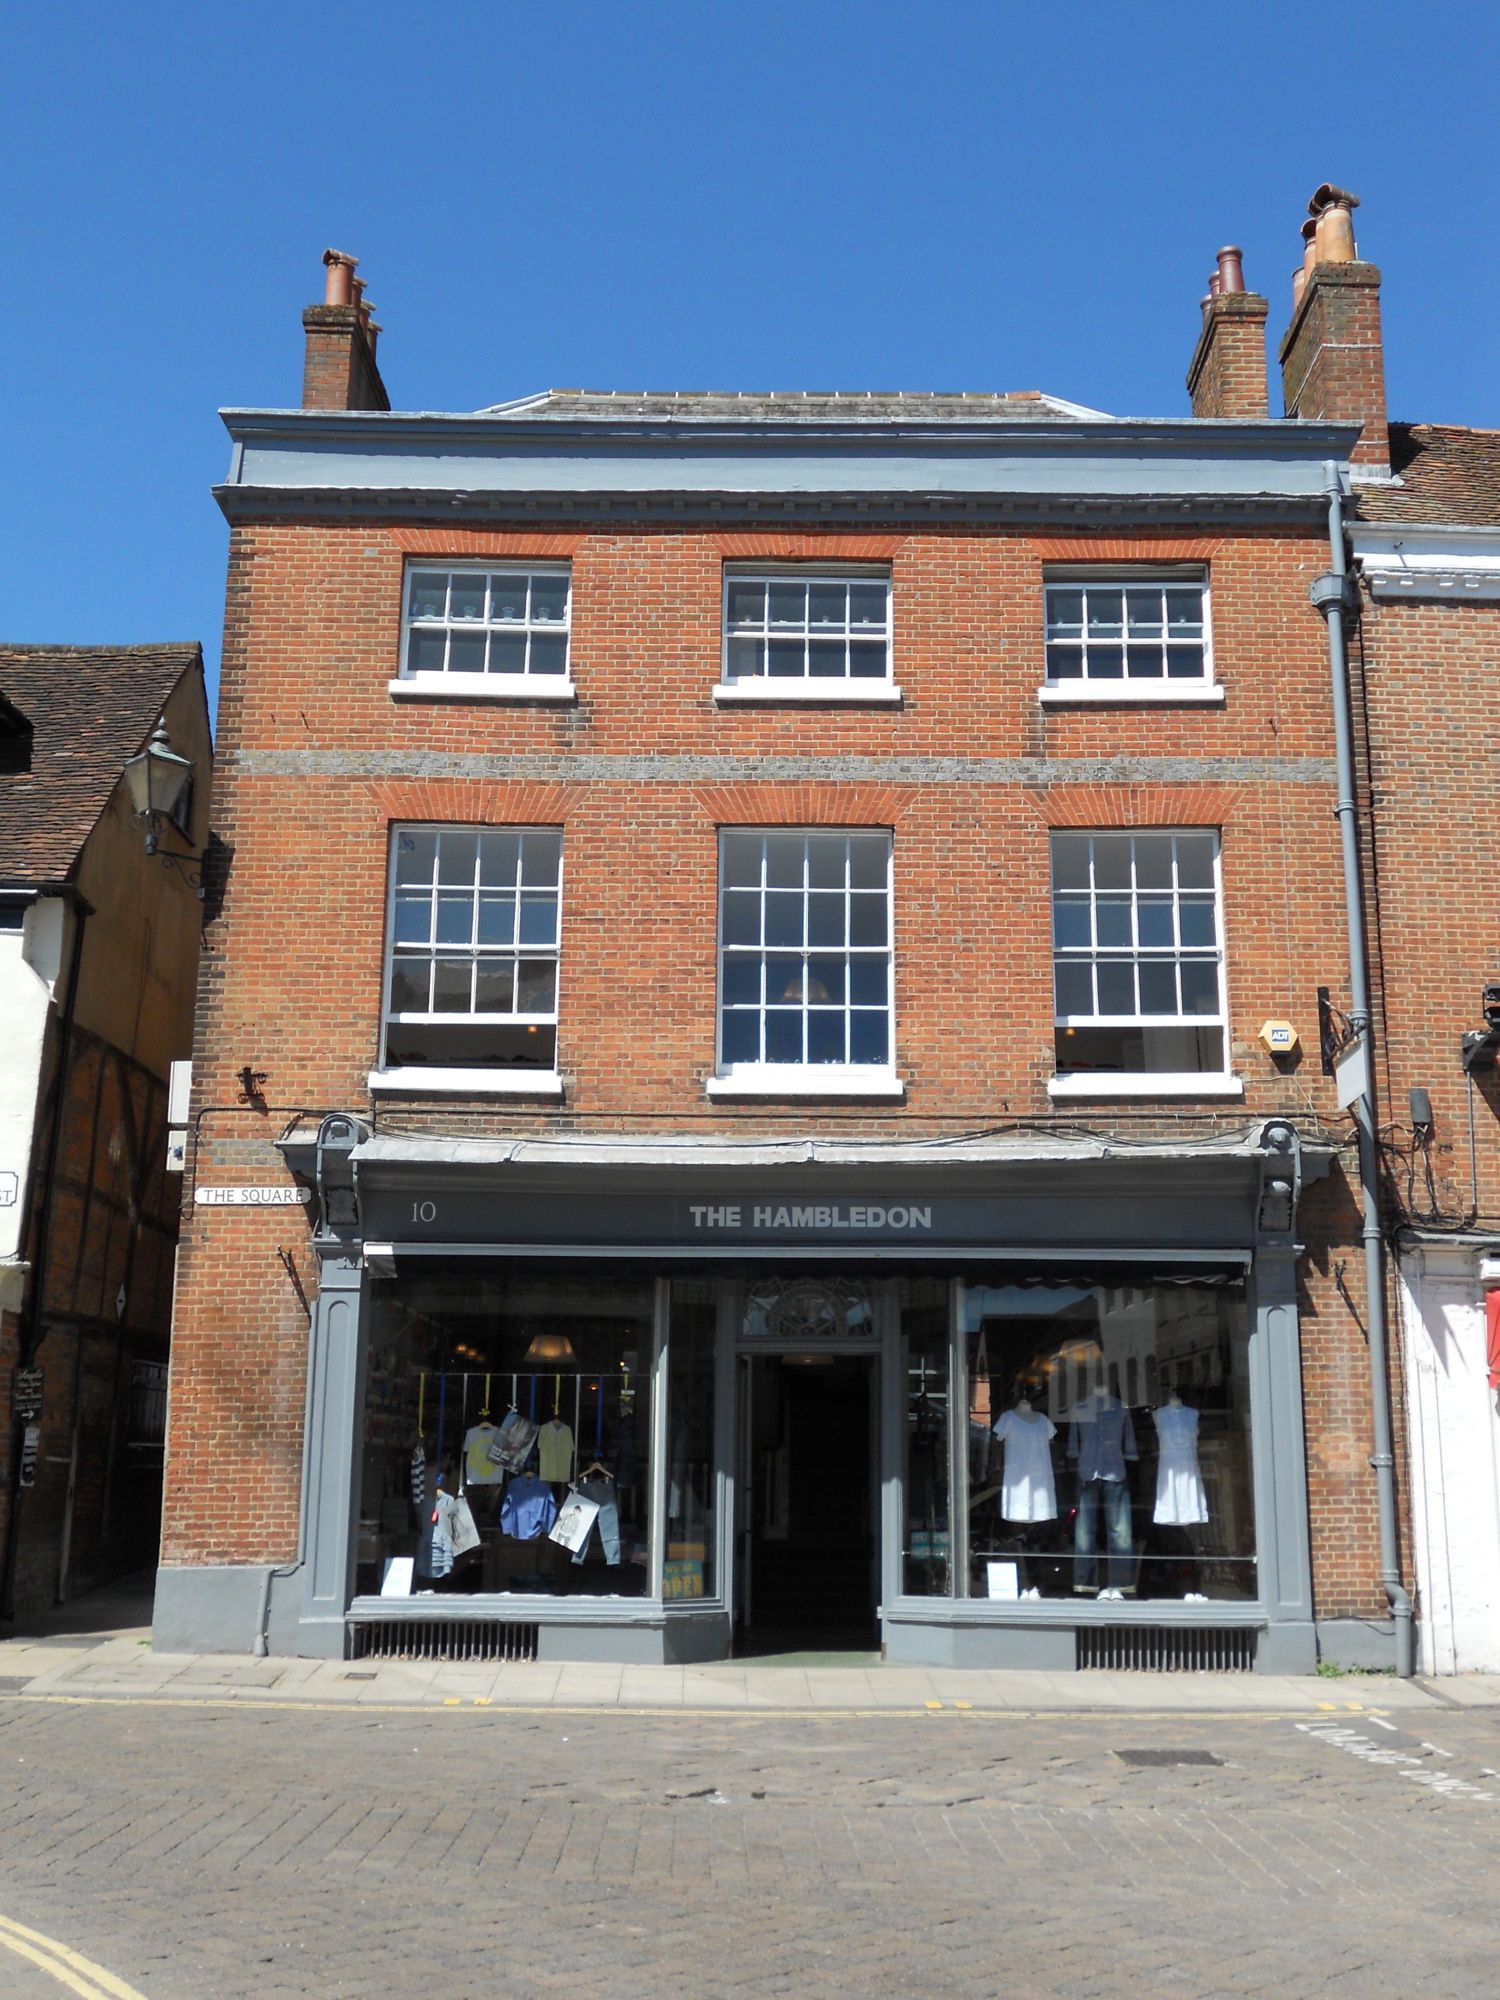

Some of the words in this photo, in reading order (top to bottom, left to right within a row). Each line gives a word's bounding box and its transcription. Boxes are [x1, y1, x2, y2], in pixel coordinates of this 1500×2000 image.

[1271, 1031, 1289, 1040] ADT
[203, 1189, 235, 1202] THE
[241, 1189, 304, 1204] SQUARE
[411, 1201, 436, 1222] 10
[690, 1206, 741, 1228] THE
[753, 1206, 932, 1229] HAMBLEDON
